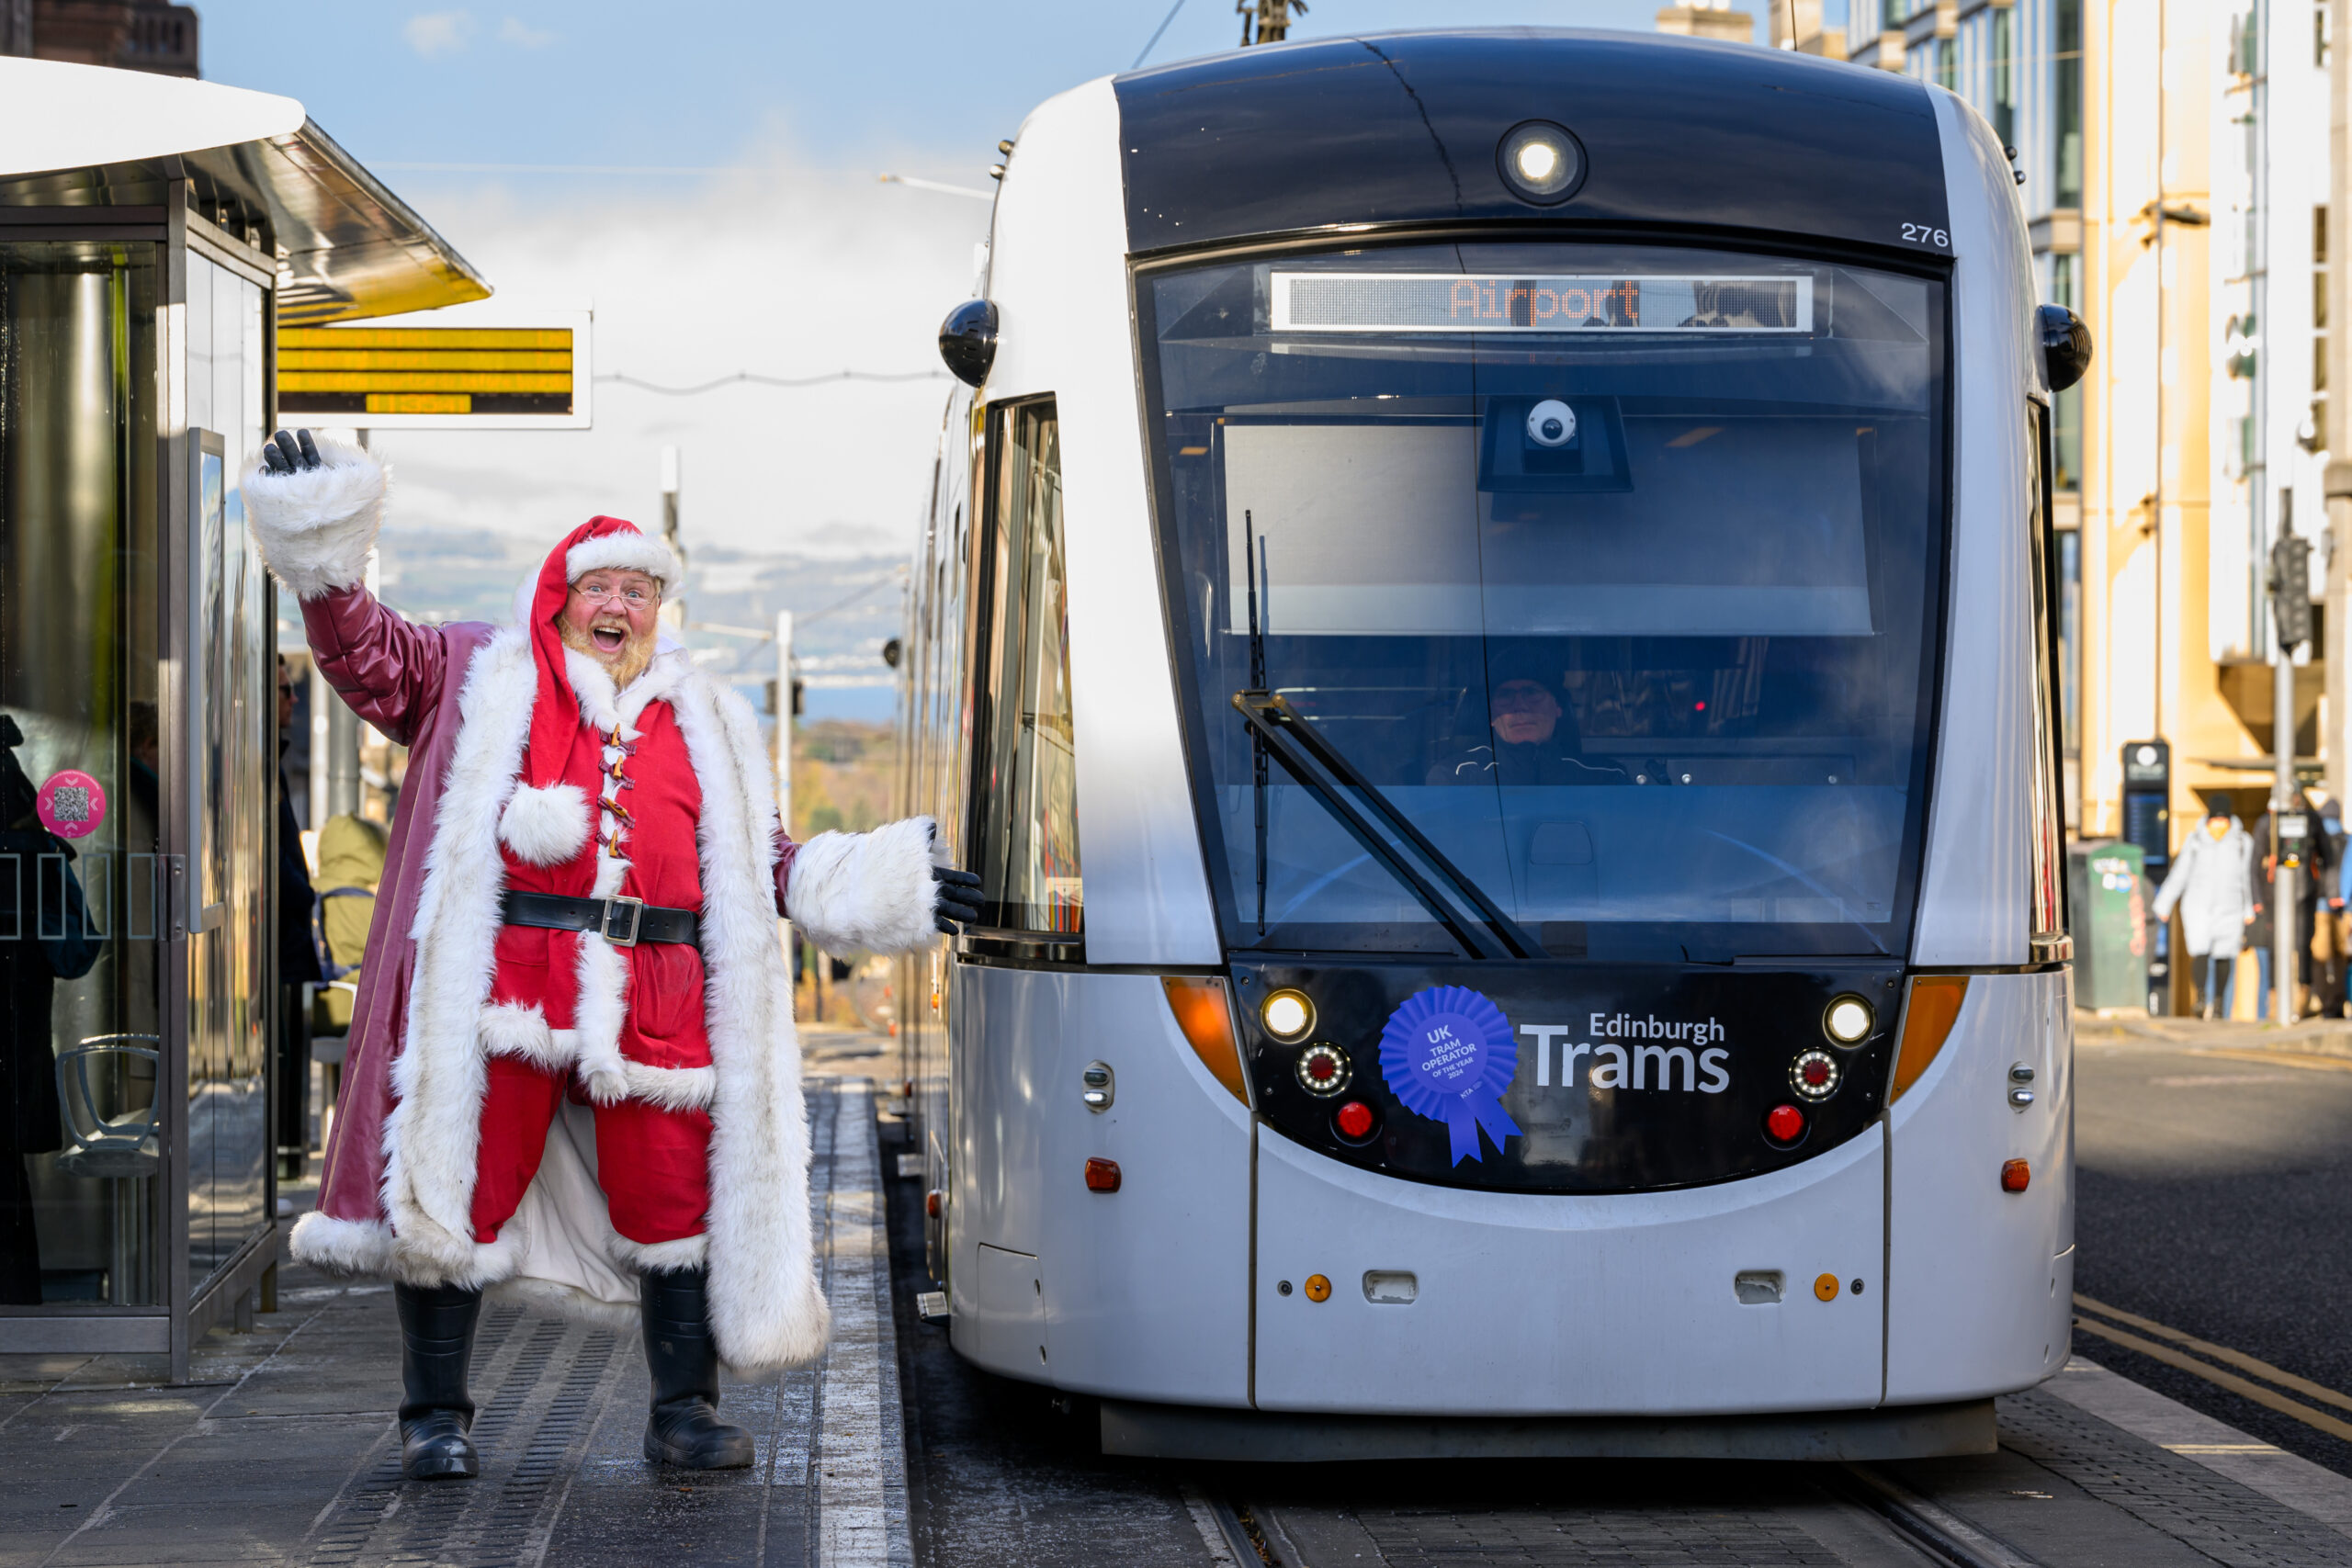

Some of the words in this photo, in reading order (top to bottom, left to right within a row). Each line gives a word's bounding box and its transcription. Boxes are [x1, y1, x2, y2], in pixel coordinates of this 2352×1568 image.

[1901, 222, 1949, 247] 276
[1451, 279, 1638, 327] Airport
[1427, 1024, 1453, 1043] UK
[1590, 1013, 1724, 1045] Edinburgh
[1421, 1043, 1477, 1071] OPERATOR
[1430, 1038, 1462, 1057] TRAM
[1520, 1024, 1730, 1093] Trams
[1432, 1069, 1442, 1077] OF
[1442, 1063, 1456, 1073] THE
[1455, 1056, 1474, 1067] YEAR
[1447, 1068, 1464, 1079] 2024
